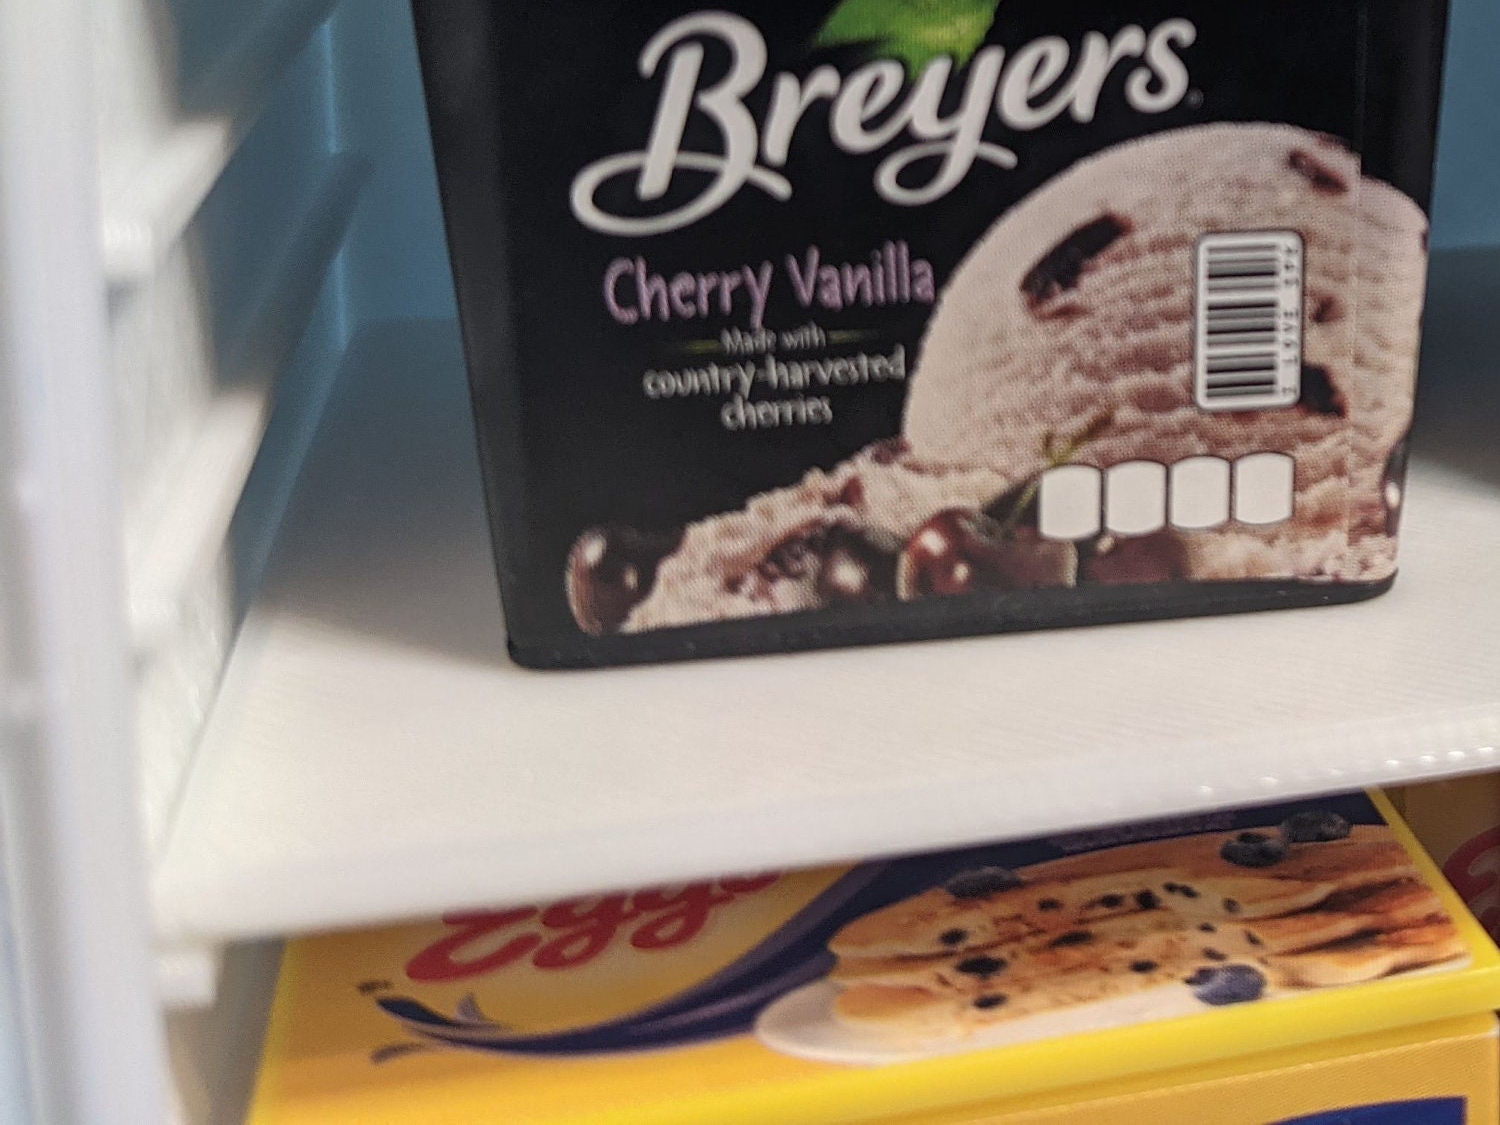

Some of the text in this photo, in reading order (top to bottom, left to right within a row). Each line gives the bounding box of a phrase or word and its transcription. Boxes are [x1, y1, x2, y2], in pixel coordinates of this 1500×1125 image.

[569, 9, 1198, 237] Breyers
[602, 238, 937, 331] Cherry Vanilla
[404, 872, 782, 983] Egg
